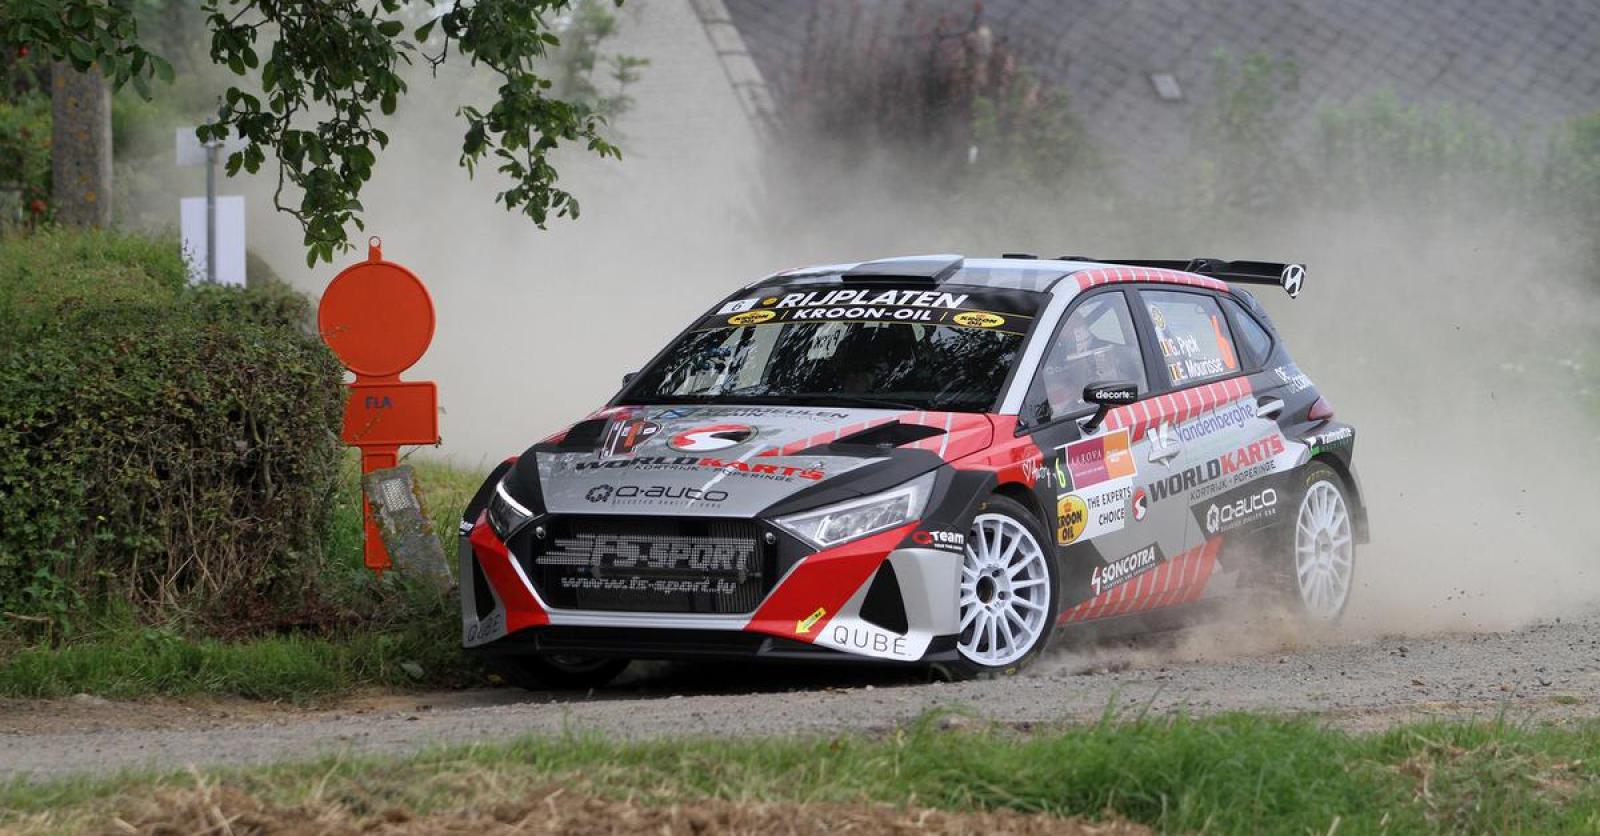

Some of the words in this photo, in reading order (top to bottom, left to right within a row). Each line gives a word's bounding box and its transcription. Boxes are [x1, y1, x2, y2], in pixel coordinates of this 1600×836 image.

[778, 290, 968, 308] RIJPLATEN
[792, 307, 931, 320] KROON-OIL
[1173, 400, 1255, 443] Vandenberghe
[1149, 433, 1285, 503] WORLDKARTS
[1088, 496, 1100, 510] THE
[1102, 486, 1131, 505] EXPERTS
[1099, 508, 1124, 526] CHOICE
[1102, 546, 1155, 584] SONCOTRA
